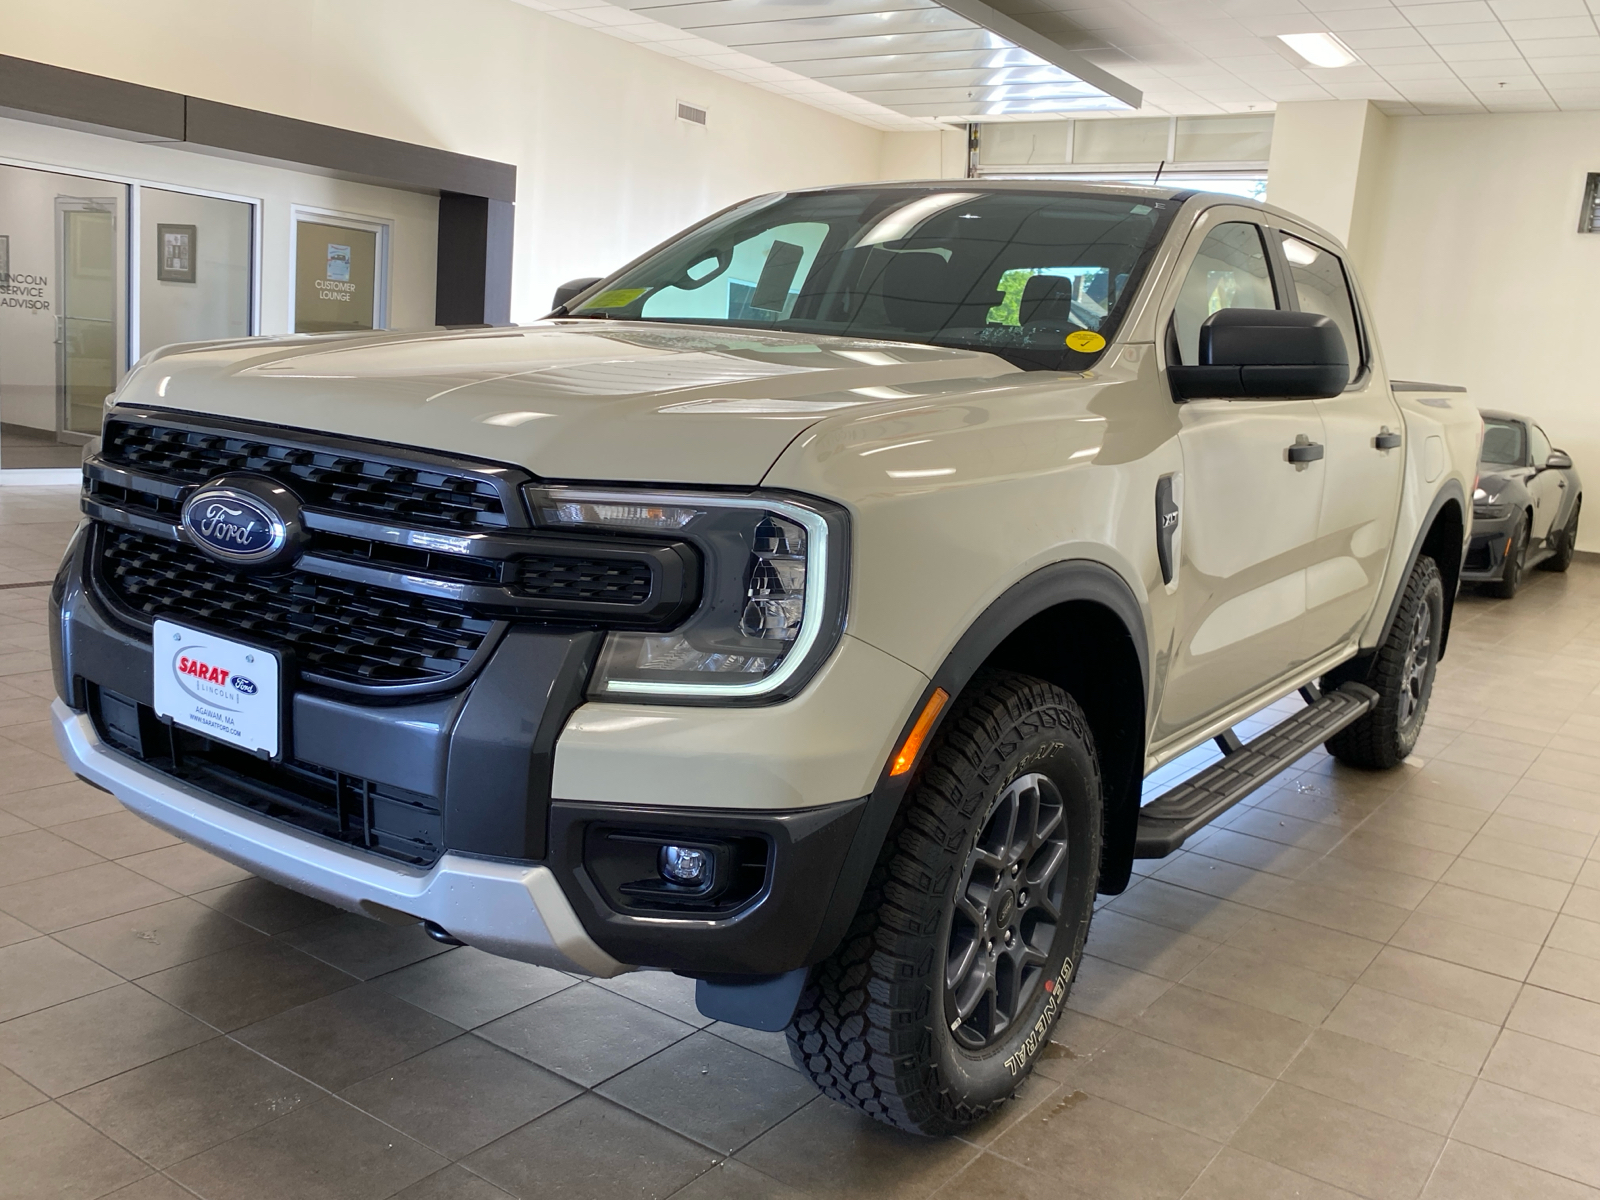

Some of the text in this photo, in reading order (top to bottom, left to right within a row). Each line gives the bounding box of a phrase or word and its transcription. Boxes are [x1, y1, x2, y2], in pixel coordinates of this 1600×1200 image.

[0, 285, 44, 298] SERVICE
[314, 279, 356, 292] CUSTOMER
[0, 297, 50, 310] ADVISOR
[319, 290, 351, 302] LOUNGE
[201, 503, 255, 546] Ford
[1162, 511, 1179, 528] XLT
[178, 655, 230, 687] SARAT
[201, 683, 235, 701] LINCOLN
[234, 677, 255, 693] Ford
[224, 715, 235, 726] MA
[1003, 956, 1074, 1076] GENERAL
